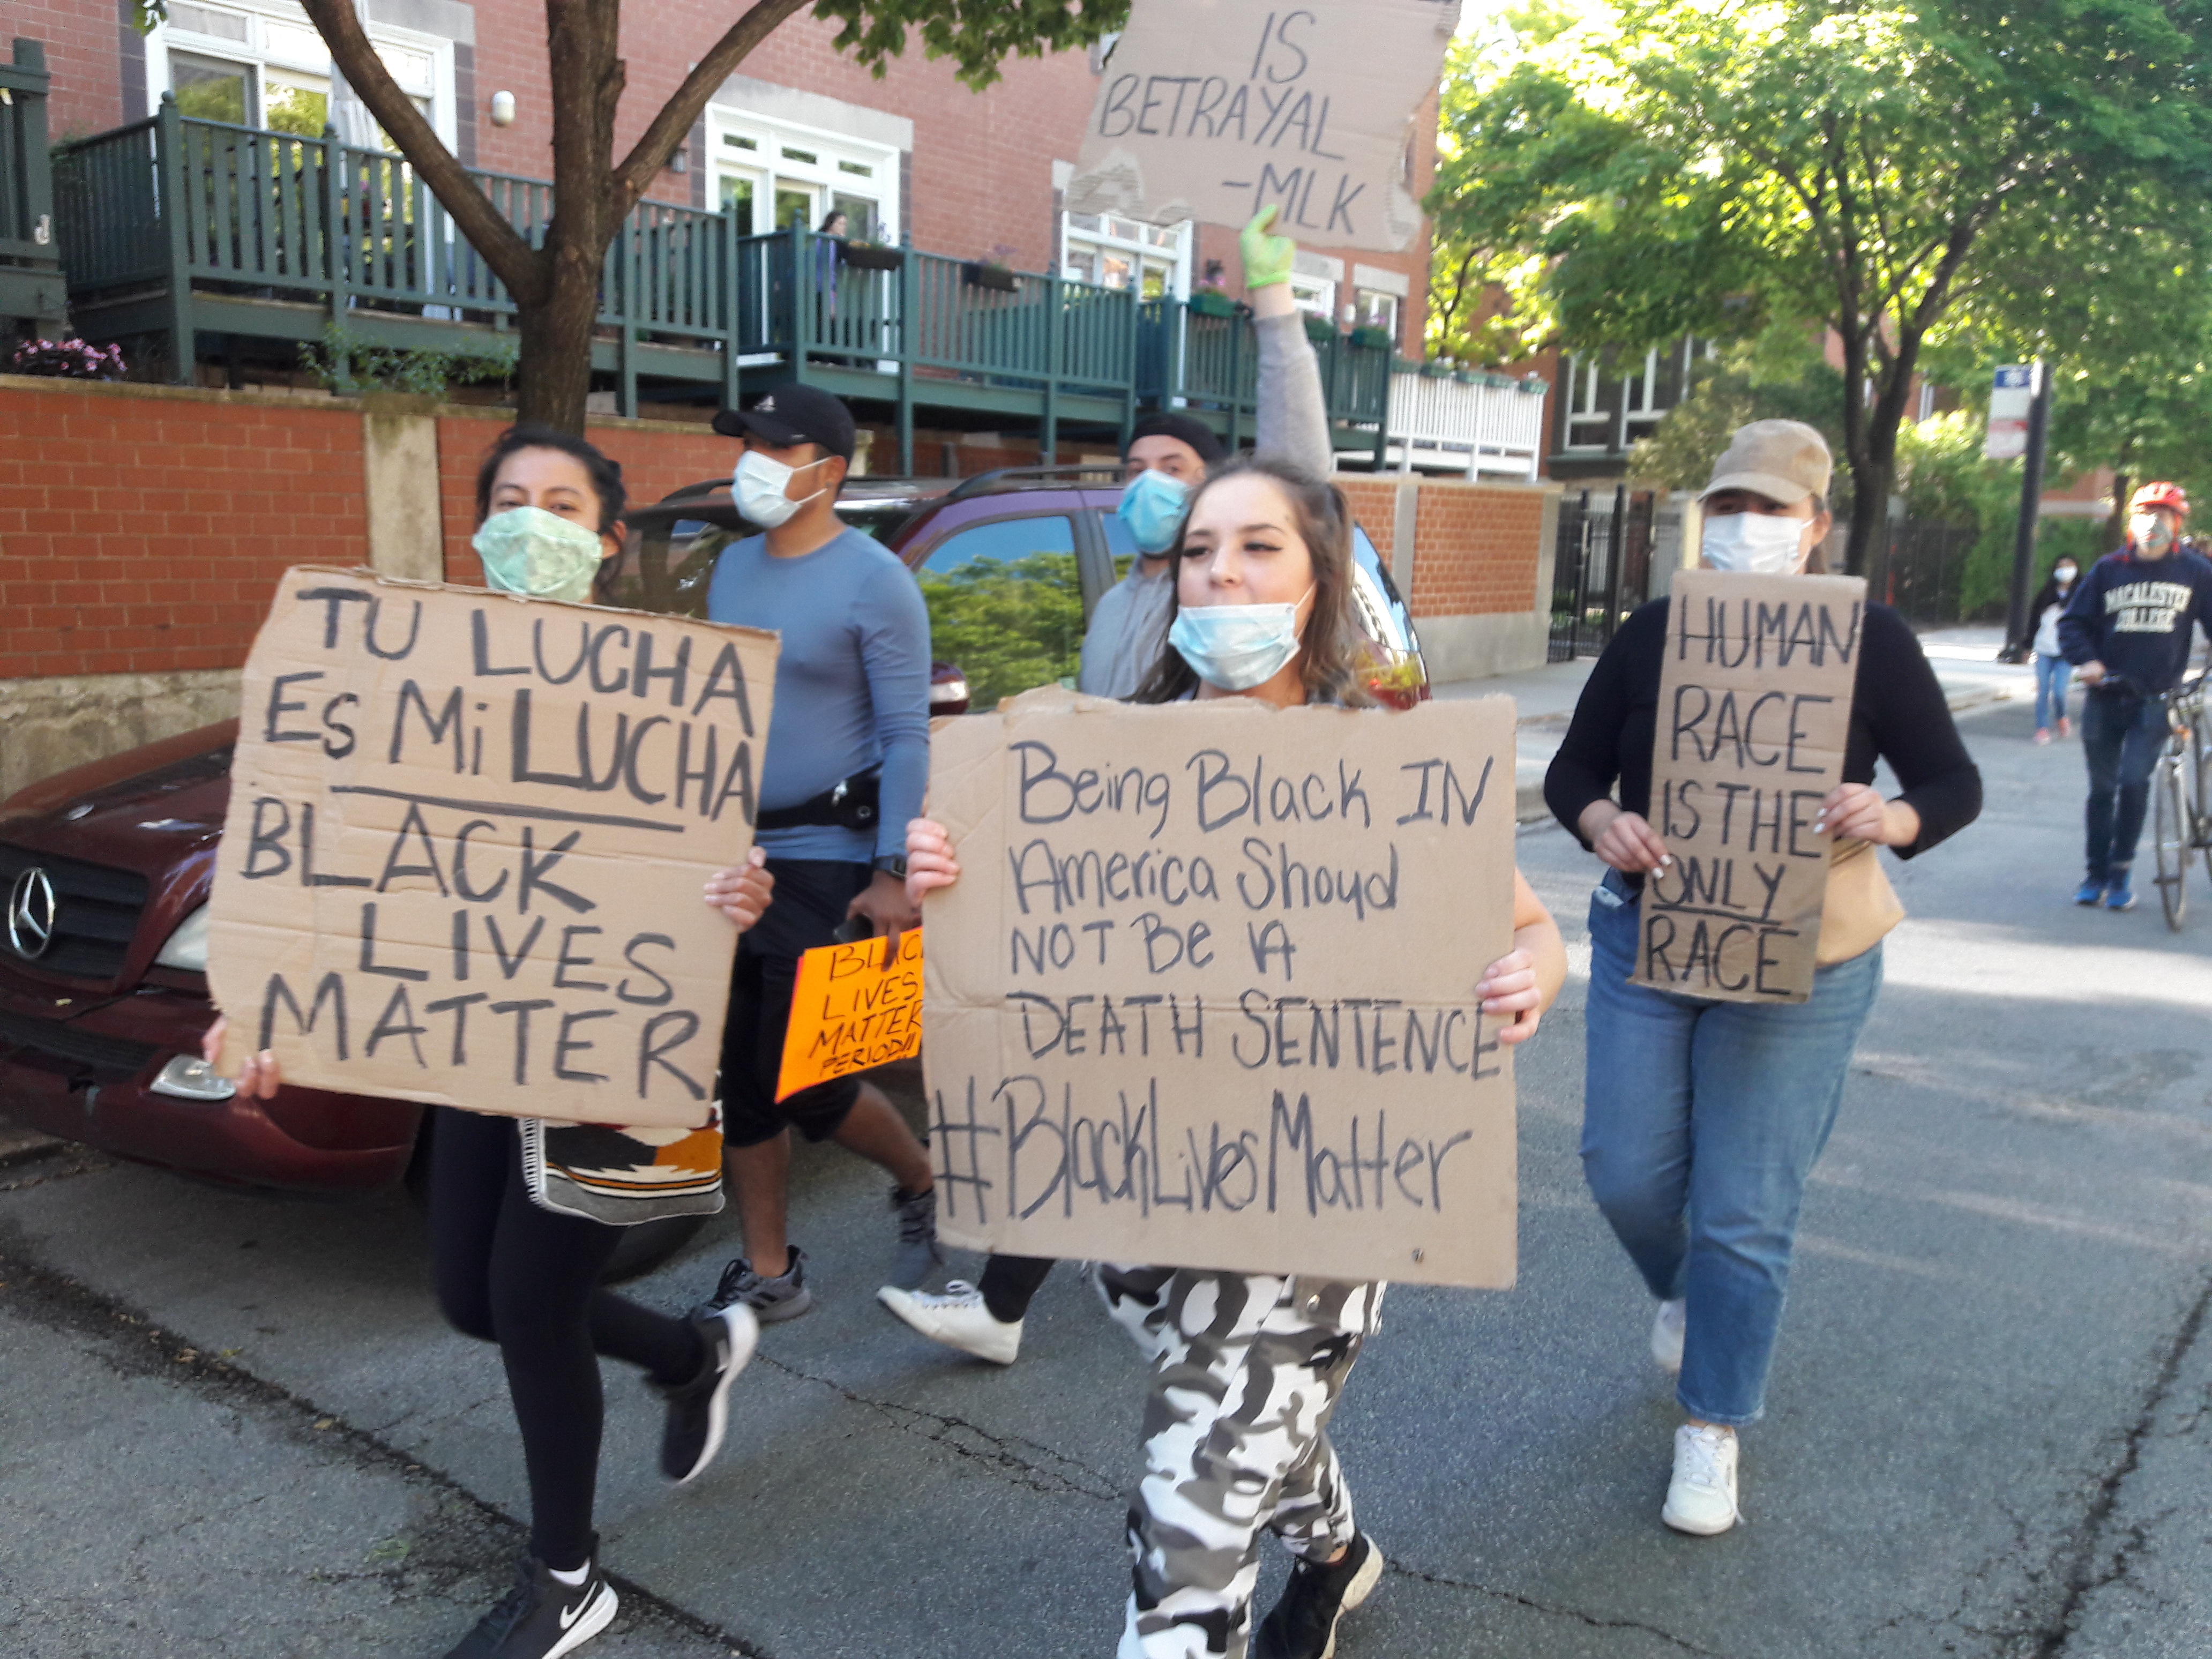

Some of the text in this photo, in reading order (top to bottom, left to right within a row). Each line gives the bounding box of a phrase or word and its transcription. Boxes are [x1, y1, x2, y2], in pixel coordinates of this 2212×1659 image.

[1250, 11, 1316, 84] IS
[1098, 73, 1344, 160] BETRAYAL
[296, 587, 754, 738] TU LUCHA
[1679, 594, 1861, 668] HUMAN
[265, 671, 360, 760] ES
[511, 688, 754, 827] LUCHA
[1671, 683, 1833, 774] RACE
[1008, 739, 1494, 840] Being Black IN
[1663, 779, 1825, 858] IS THE
[240, 796, 596, 914] BLACK
[1008, 839, 1220, 915] America
[1652, 854, 1785, 921] ONLY
[359, 902, 676, 1006] LIVES
[829, 934, 923, 982] BLC
[1008, 920, 1115, 975] NOT
[1247, 919, 1297, 980] A
[1646, 914, 1799, 996] RACE
[258, 972, 706, 1101] MATTER
[823, 972, 918, 1020] LIVES
[1006, 987, 1501, 1080] DEATH SENTENCE
[929, 1074, 1473, 1224] #BlackLivesMatter
